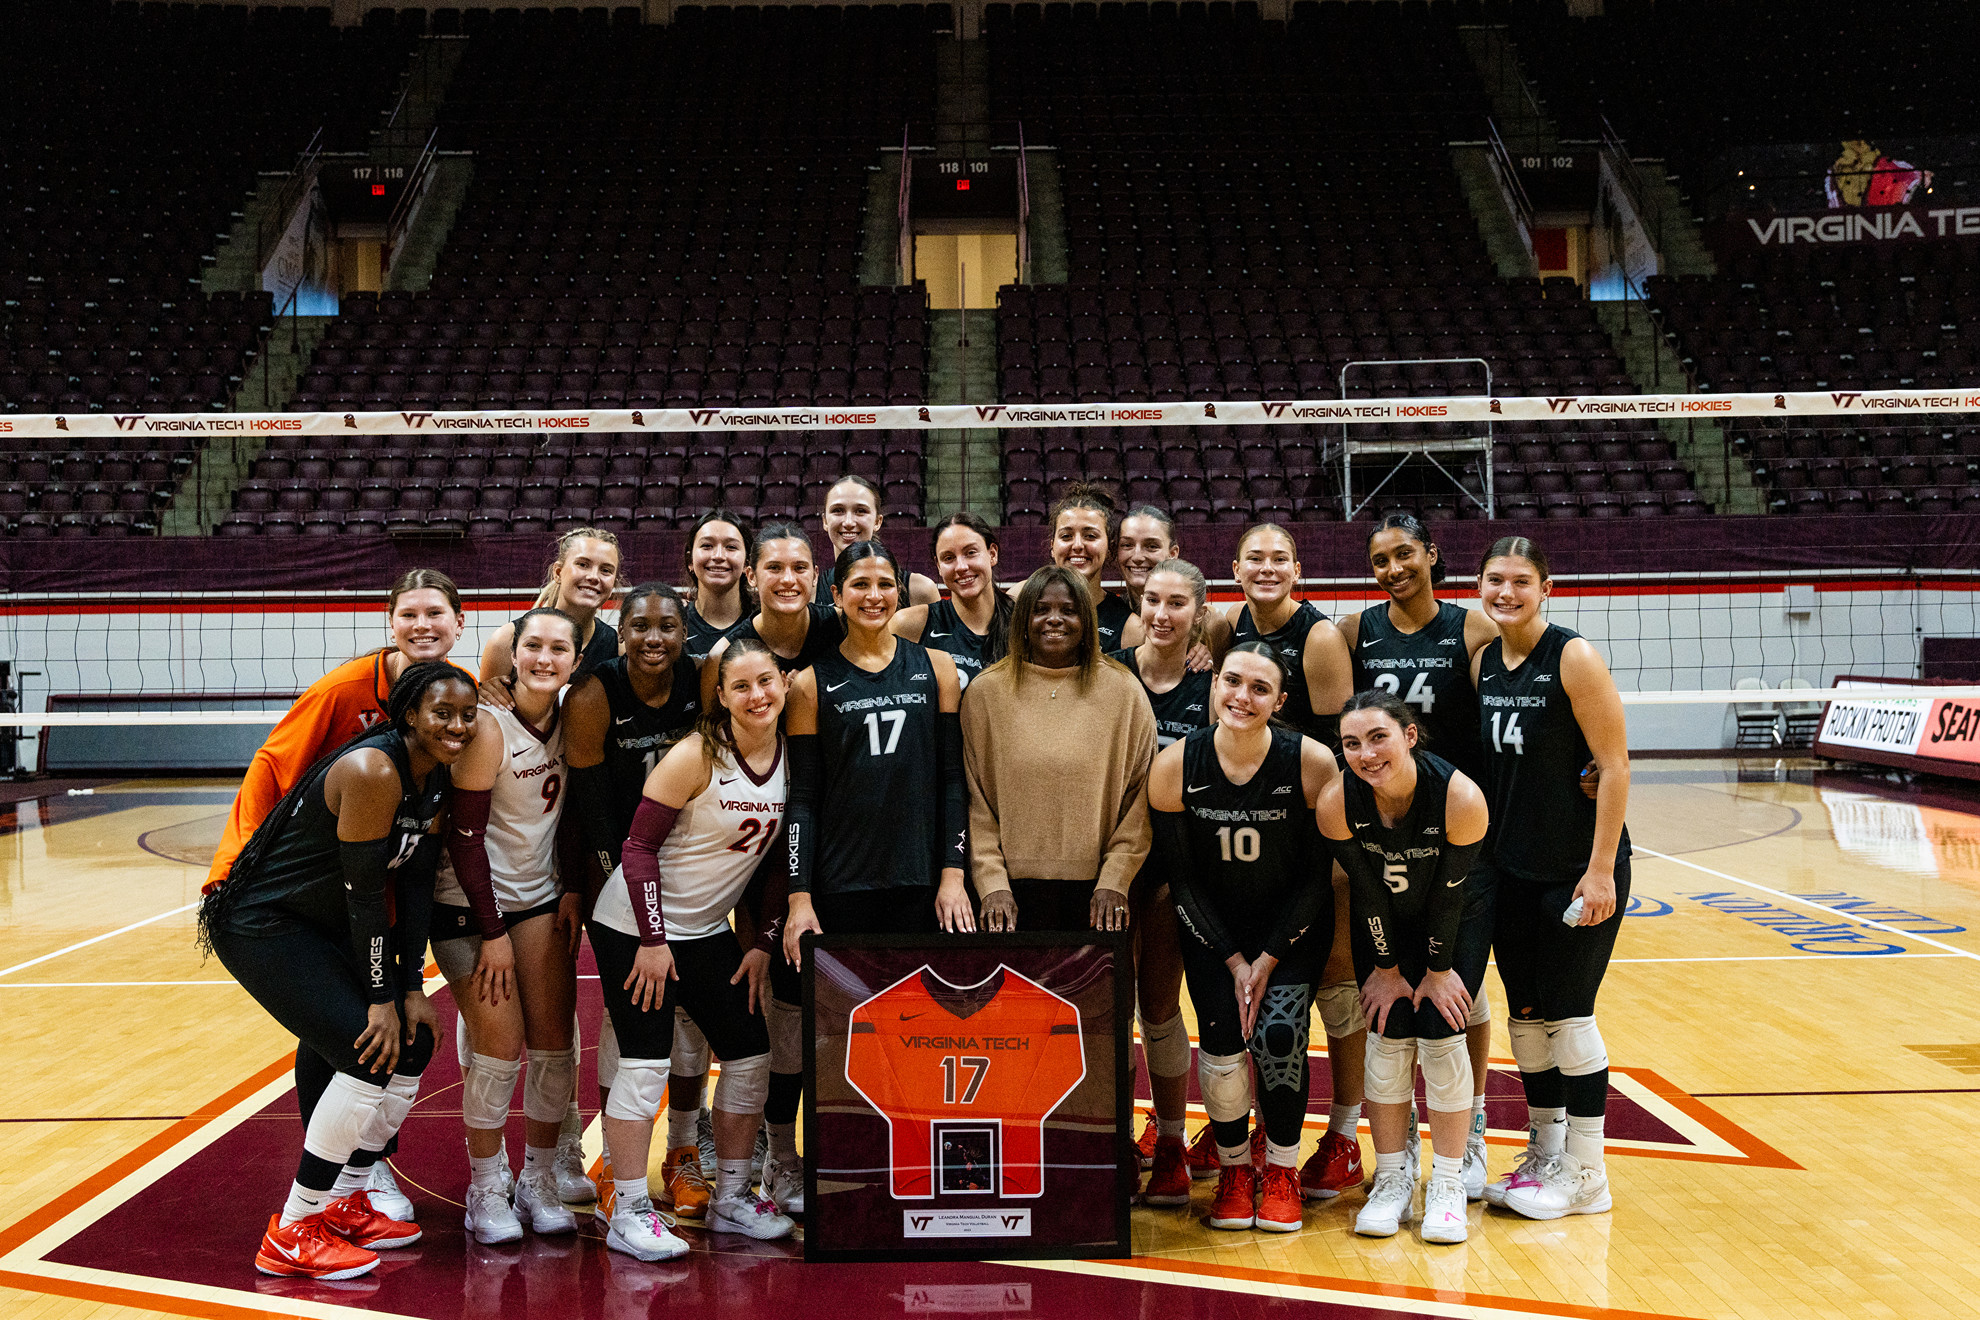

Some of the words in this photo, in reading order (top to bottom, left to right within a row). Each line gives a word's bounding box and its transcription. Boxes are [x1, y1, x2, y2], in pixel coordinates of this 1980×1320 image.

[939, 161, 960, 174] 118
[970, 161, 989, 173] 101
[1521, 156, 1541, 169] 101
[1551, 156, 1573, 169] 102
[353, 167, 372, 179] 117
[384, 167, 404, 179] 118
[1747, 211, 1925, 245] VIRGINIA
[1928, 206, 1980, 237] TE
[1545, 397, 1578, 414] VT
[1577, 402, 1637, 413] VIRGINIA
[1638, 401, 1675, 413] TECH
[1681, 400, 1732, 412] HOKIES
[1831, 393, 1862, 409] VT
[1861, 398, 1921, 409] VIRGINIA
[1922, 397, 1960, 408] TECH
[689, 409, 721, 426] VT
[719, 415, 781, 426] VIRGINIA
[781, 414, 819, 425] TECH
[825, 413, 877, 425] HOKIES
[975, 405, 1008, 422] VT
[1006, 410, 1067, 422] VIRGINIA
[1068, 410, 1105, 421] TECH
[1111, 409, 1163, 420] HOKIES
[1261, 402, 1293, 419] VT
[1292, 407, 1352, 418] VIRGINIA
[1353, 406, 1390, 417] TECH
[1396, 406, 1448, 417] HOKIES
[113, 414, 146, 431] VT
[145, 420, 206, 432] VIRGINIA
[207, 420, 244, 430] TECH
[250, 419, 302, 431] HOKIES
[401, 412, 433, 428] VT
[432, 417, 494, 429] VIRGINIA
[495, 417, 532, 428] TECH
[538, 417, 590, 428] HOKIES
[1437, 638, 1457, 647] ACC
[950, 653, 982, 669] GINIA
[1362, 659, 1416, 670] VIRGINIA
[1417, 657, 1453, 669] TECH
[909, 673, 928, 681] ACC
[1533, 674, 1552, 682] ACC
[833, 695, 894, 714] VIRGINIA
[892, 693, 927, 705] TECH
[1515, 696, 1546, 708] TECH
[1825, 705, 1875, 740] ROCKIN'
[1866, 708, 1922, 746] PROTEIN
[1931, 701, 1980, 743] SEAT
[863, 709, 907, 757] 17
[1490, 711, 1524, 755] 14
[512, 757, 560, 779] VIRGINIA
[541, 773, 561, 815] 9
[1271, 785, 1293, 795] ACC
[719, 799, 771, 813] VIRGINIA
[771, 802, 784, 813] TE
[1190, 805, 1250, 822] VIRGINIA
[1250, 808, 1287, 821] TECH
[726, 817, 779, 856] 21
[1422, 826, 1440, 835] ACC
[789, 822, 800, 877] HOKIES
[1215, 826, 1261, 863] 10
[1404, 846, 1440, 860] TECH
[597, 850, 614, 878] KIES
[1382, 861, 1410, 894] 5
[643, 881, 664, 935] HOKIES
[457, 915, 467, 927] 9
[1674, 891, 1907, 956] CARILION
[1367, 916, 1390, 956] HOKIES
[370, 936, 384, 988] HOKIES
[899, 1035, 980, 1050] VIRGINIA
[982, 1037, 1030, 1051] TECH
[939, 1055, 991, 1105] 17
[910, 1216, 934, 1230] VT
[1001, 1215, 1024, 1230] VT
